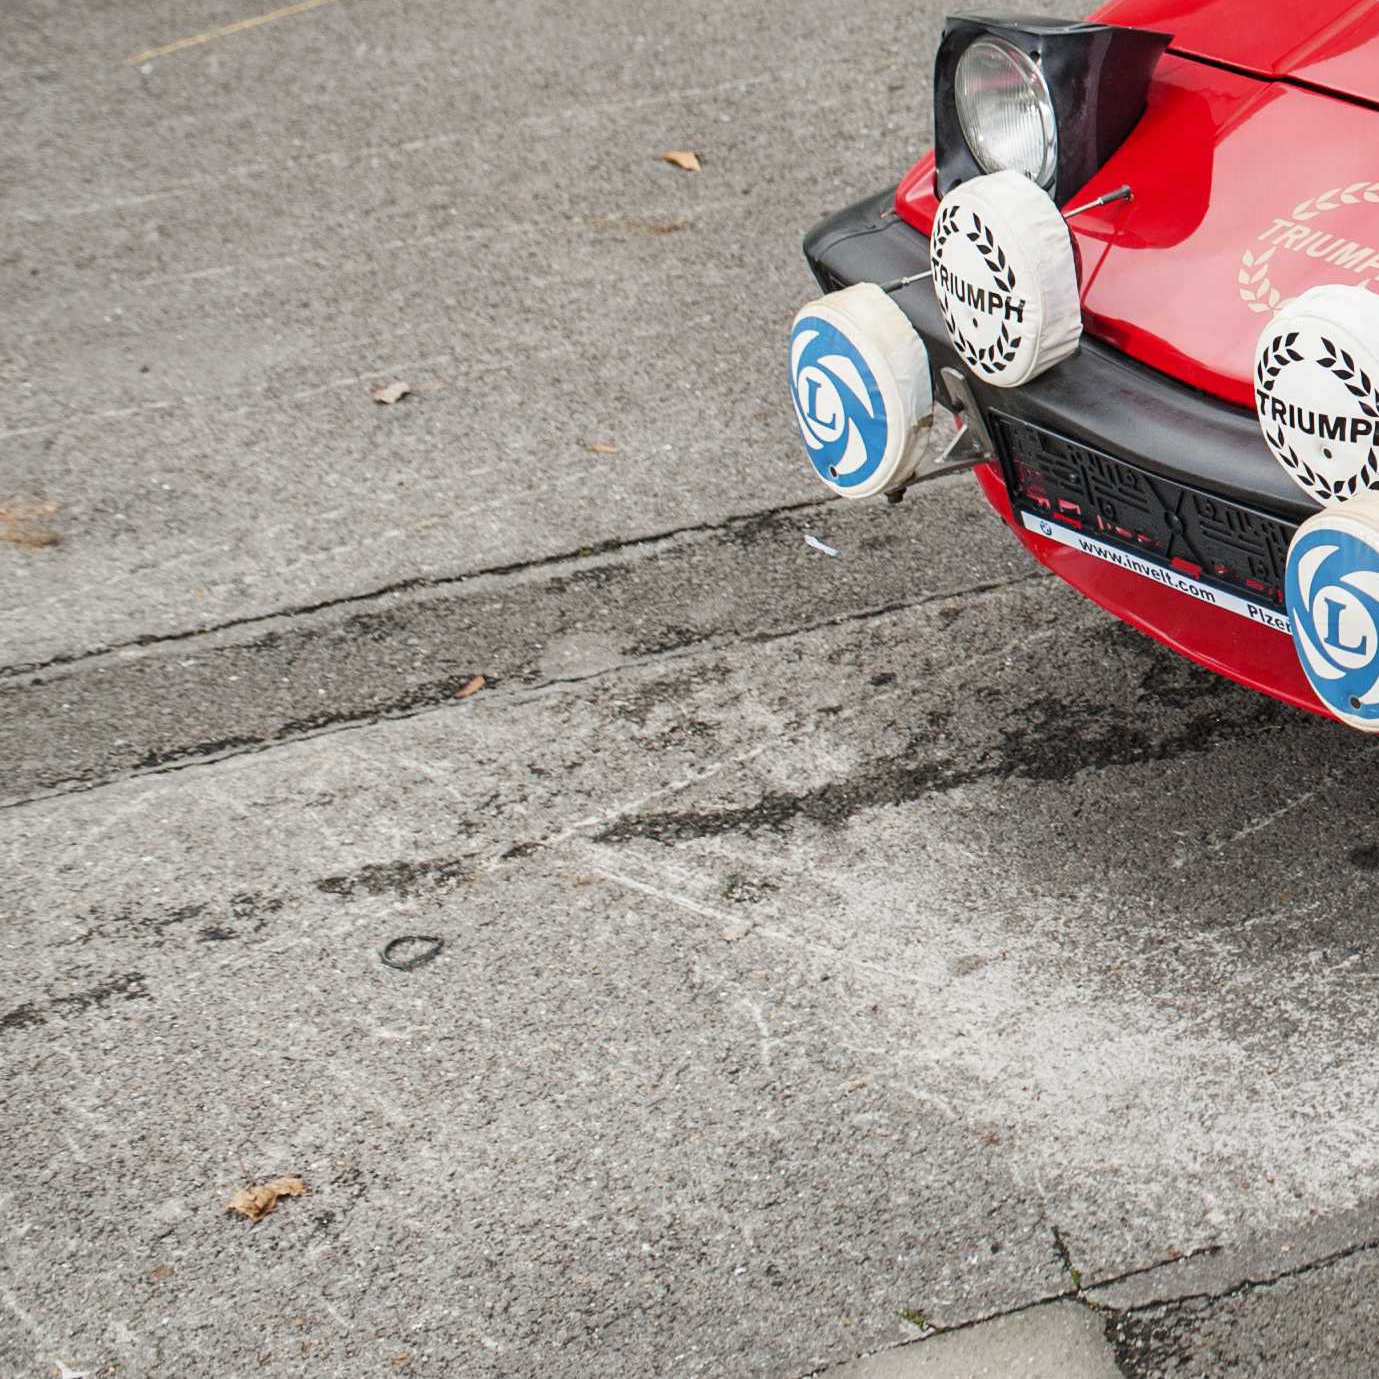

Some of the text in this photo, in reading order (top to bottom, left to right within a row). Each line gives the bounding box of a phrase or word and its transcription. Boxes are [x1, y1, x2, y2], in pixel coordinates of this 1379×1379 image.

[931, 257, 1026, 324] TRIUMPH
[806, 376, 837, 431] L
[1078, 538, 1217, 603] www.invelt.com
[1323, 596, 1367, 656] L
